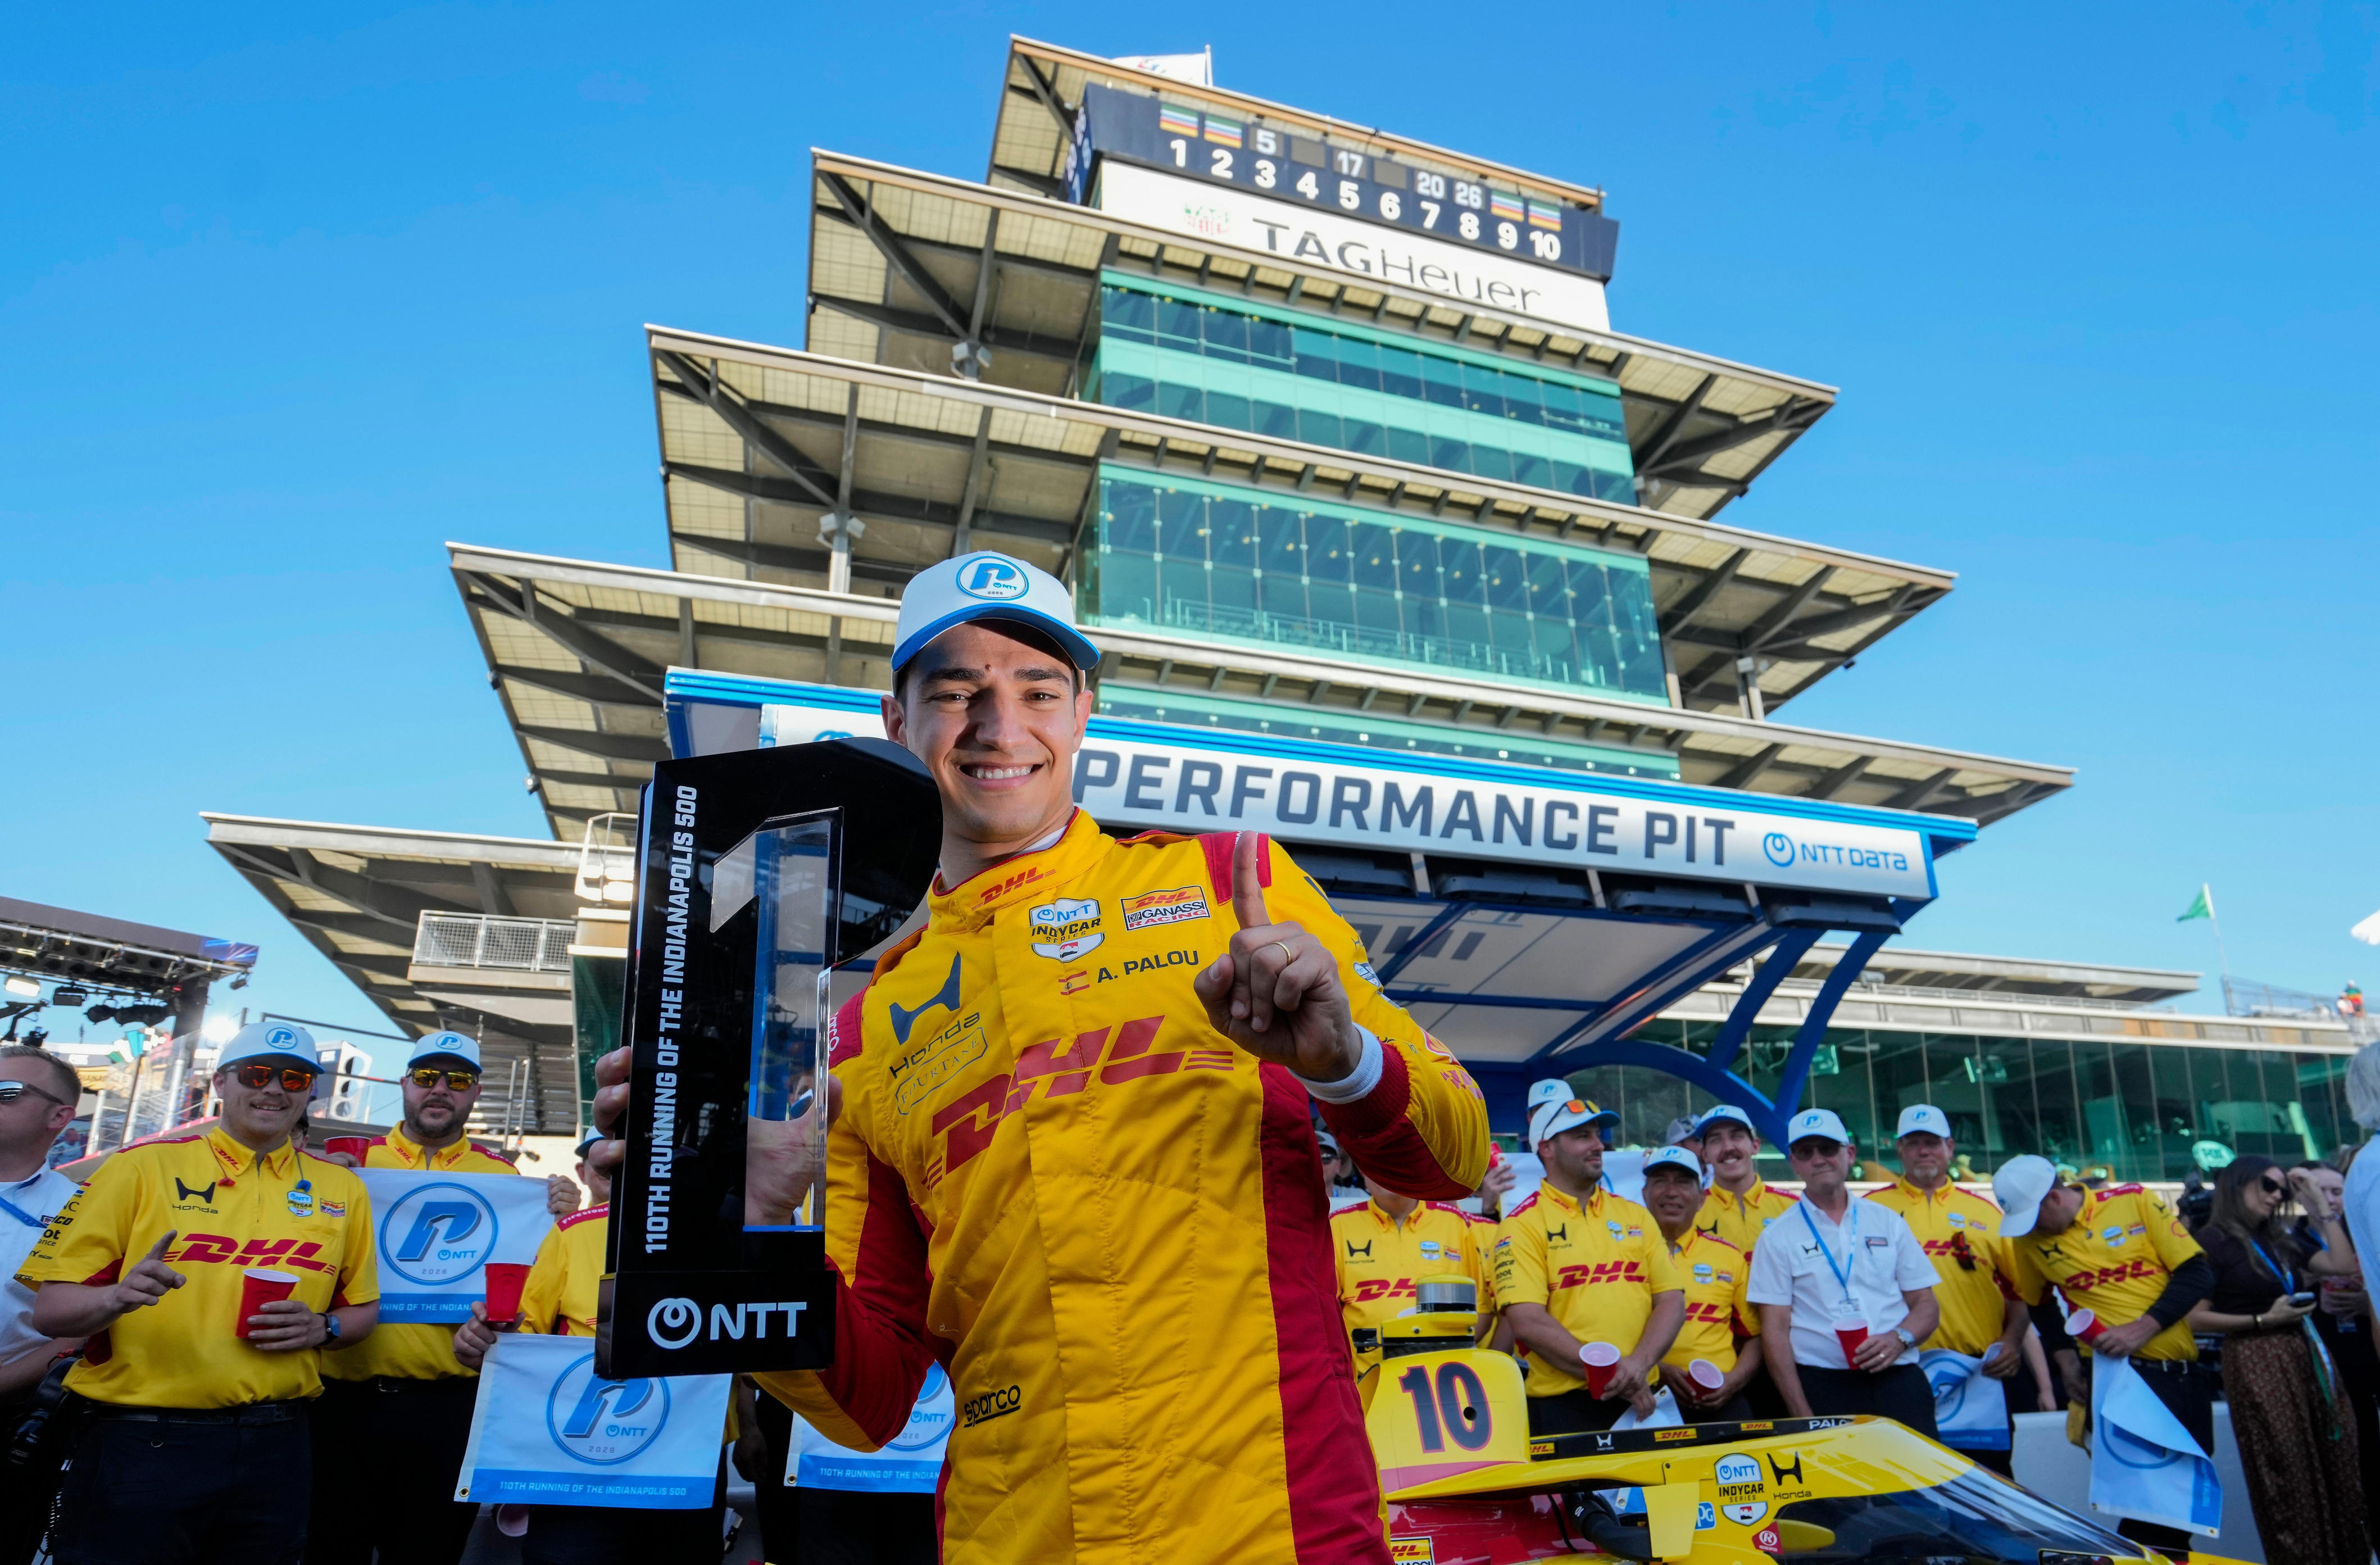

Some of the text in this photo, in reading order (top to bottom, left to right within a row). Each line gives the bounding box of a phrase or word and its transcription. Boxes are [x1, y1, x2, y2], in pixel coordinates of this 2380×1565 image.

[1256, 128, 1482, 210] 5 17 20 26
[1170, 139, 1561, 261] 1 2 3 4 5 6 7 8 9 10
[1073, 749, 1736, 866] PERFORMANCE PIT
[1801, 843, 1844, 864] NTT
[980, 867, 1045, 904] DHL
[1135, 891, 1191, 909] DHL
[1142, 901, 1205, 918] GANASSI
[1057, 905, 1091, 922] NTT
[1129, 910, 1207, 928] RACING
[1032, 918, 1101, 937] INDYCAR
[1046, 931, 1087, 943] SERIES
[1097, 950, 1199, 983] A. PALOU
[645, 785, 697, 1254] 110TH RUNNING OF THE INDIANAPOLIS 500
[889, 1012, 980, 1079] Honda
[932, 1014, 1187, 1176] DHL
[219, 1149, 239, 1171] DHL
[172, 1204, 219, 1214] Honda
[177, 1233, 328, 1272] DHL
[1557, 1260, 1646, 1290] DHL
[2065, 1261, 2155, 1291] DHL
[1355, 1278, 1416, 1303] DH
[710, 1302, 807, 1340] NTT
[964, 1385, 1021, 1427] sparco
[1398, 1362, 1492, 1453] 10
[924, 1413, 946, 1423] NTT
[621, 1427, 647, 1437] NTT
[820, 1468, 843, 1476] 110TH
[845, 1469, 880, 1478] RUNNING
[1733, 1465, 1755, 1477] NTT
[499, 1481, 526, 1490] 110TH
[529, 1482, 570, 1492] RUNNING
[587, 1485, 603, 1494] THE
[605, 1486, 666, 1495] INDIANAPOLIS
[1719, 1484, 1764, 1497] INDYCAR
[1773, 1490, 1812, 1499] Honda
[1391, 1545, 1420, 1557] HL
